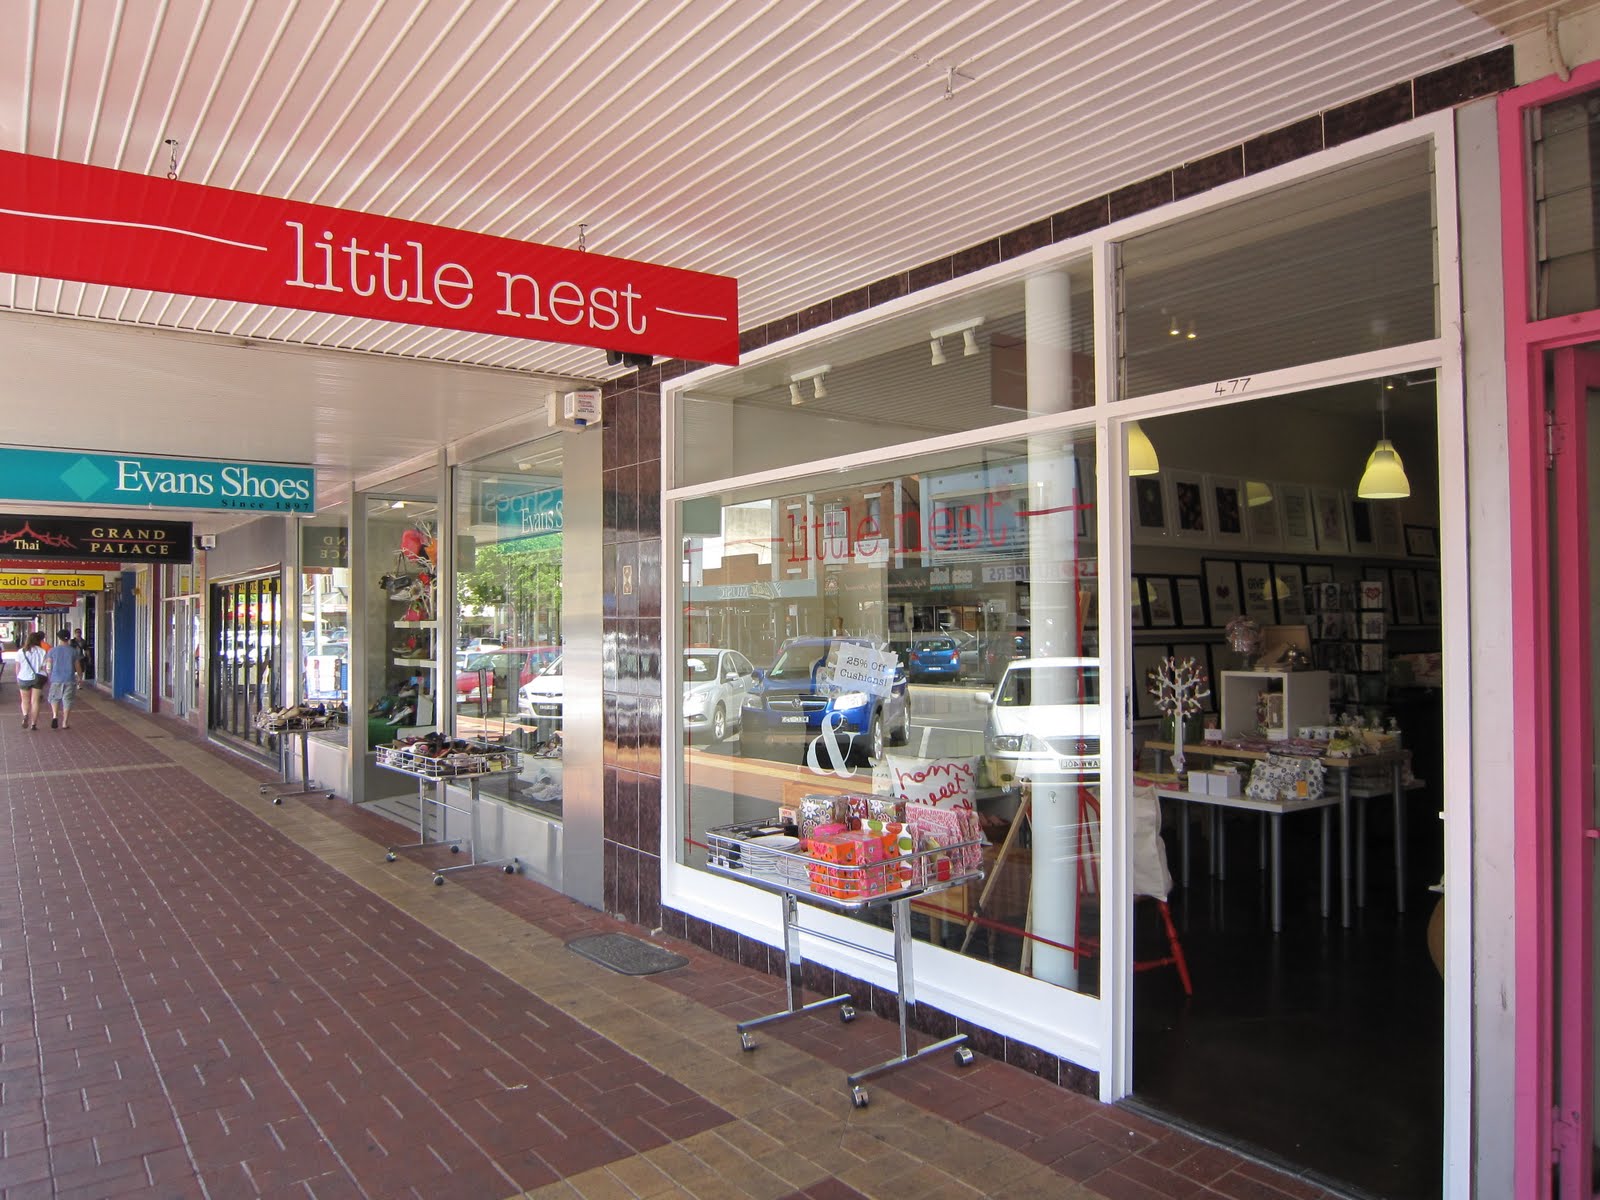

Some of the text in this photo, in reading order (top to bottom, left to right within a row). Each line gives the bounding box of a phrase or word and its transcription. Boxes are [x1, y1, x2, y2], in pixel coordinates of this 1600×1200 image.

[285, 221, 648, 335] little nest
[1215, 377, 1251, 396] 477
[114, 460, 310, 500] Evans Shoes
[221, 499, 310, 511] Since 1897
[521, 507, 554, 534] Evans
[787, 490, 1008, 563] little nest
[91, 527, 166, 540] GRAND
[14, 539, 40, 551] Thai
[90, 542, 169, 555] PALACE
[47, 578, 86, 587] rentals
[846, 656, 888, 673] 25% Off
[840, 668, 887, 687] Cushions!
[806, 711, 861, 778] &
[895, 763, 974, 791] home
